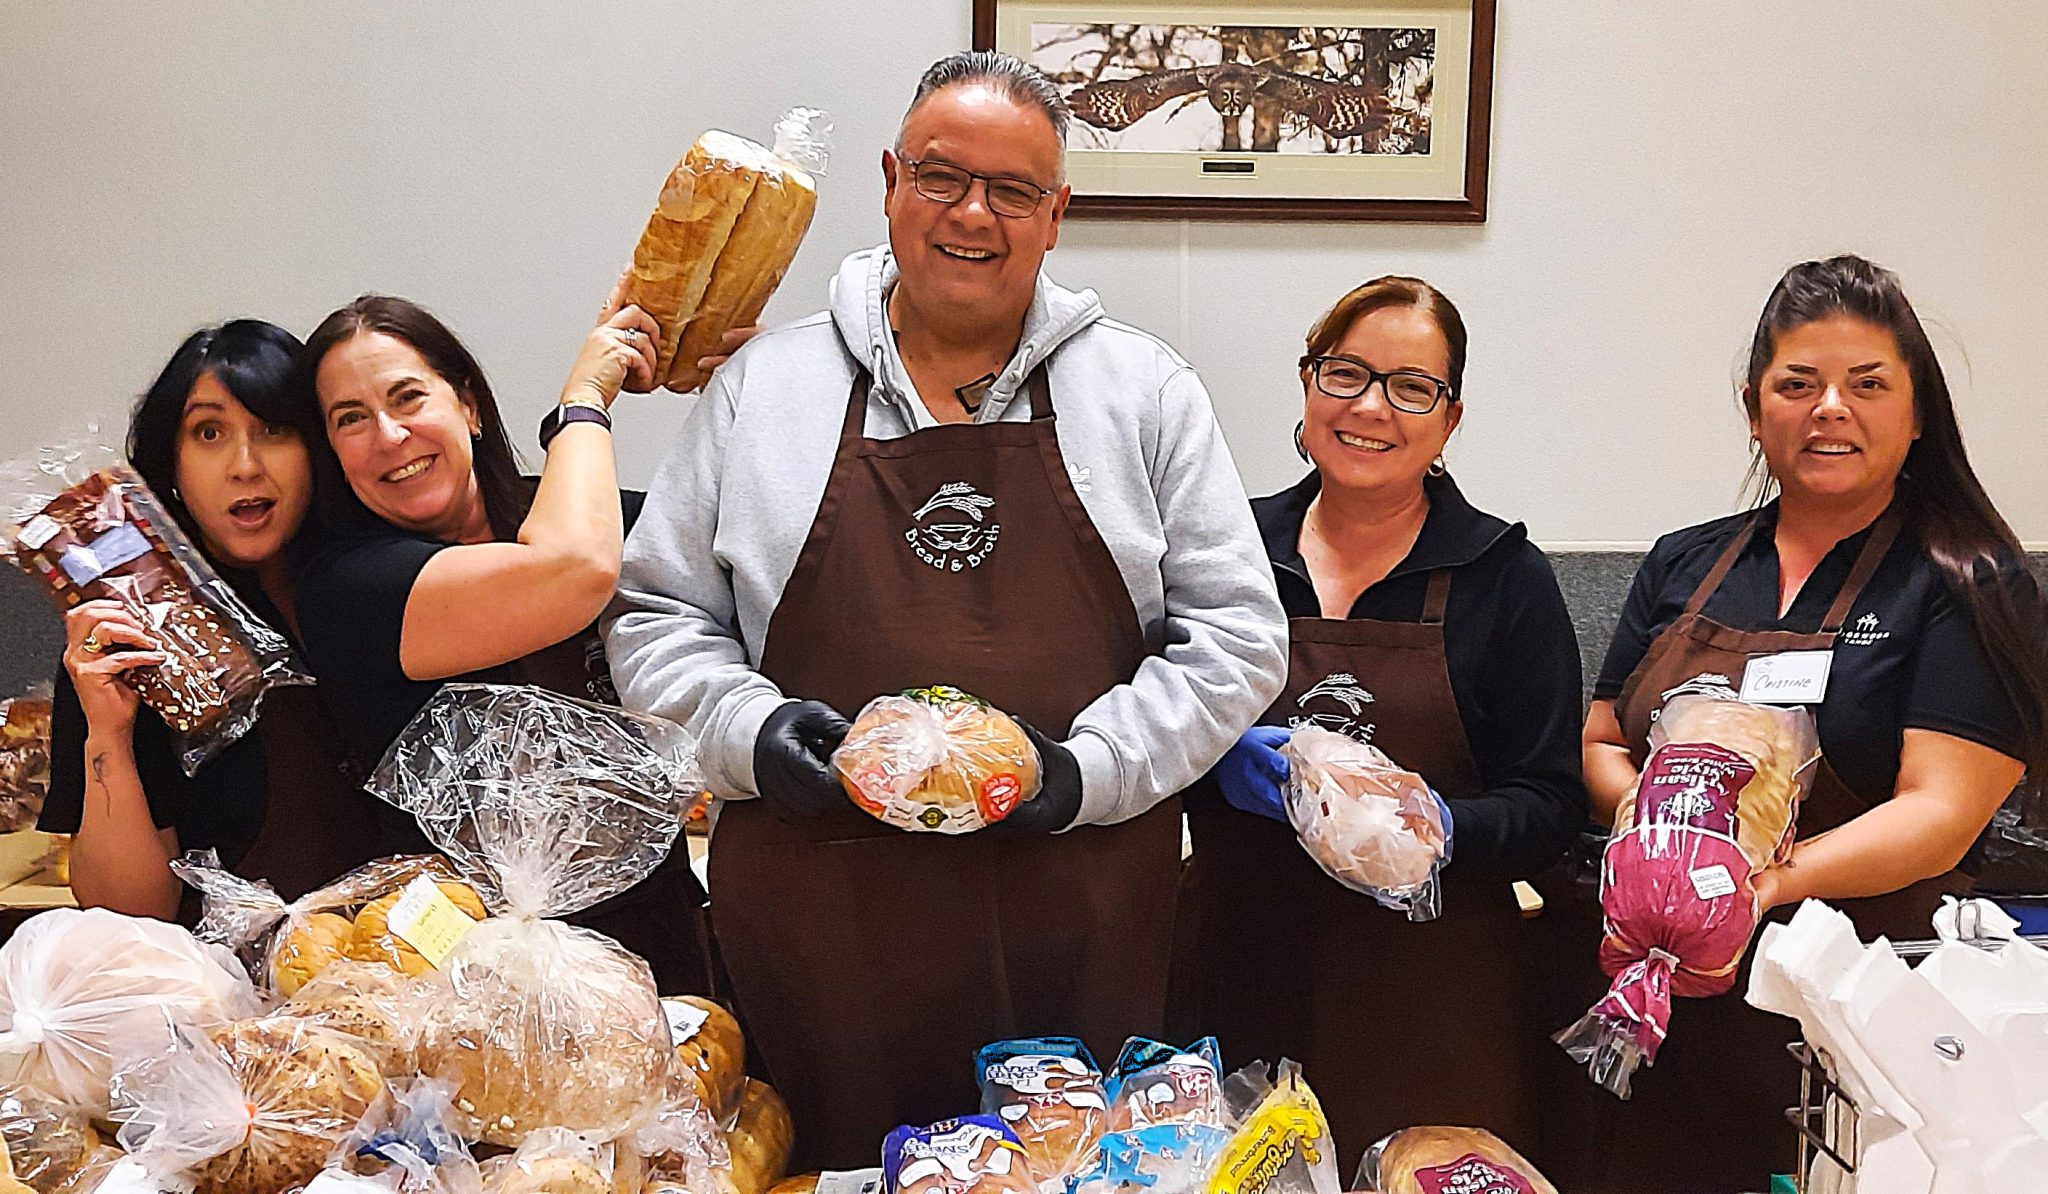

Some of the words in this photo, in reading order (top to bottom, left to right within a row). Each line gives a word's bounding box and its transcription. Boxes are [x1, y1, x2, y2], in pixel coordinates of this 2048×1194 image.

[905, 528, 947, 569] Bread
[951, 559, 963, 571] &
[967, 525, 1000, 567] Broth
